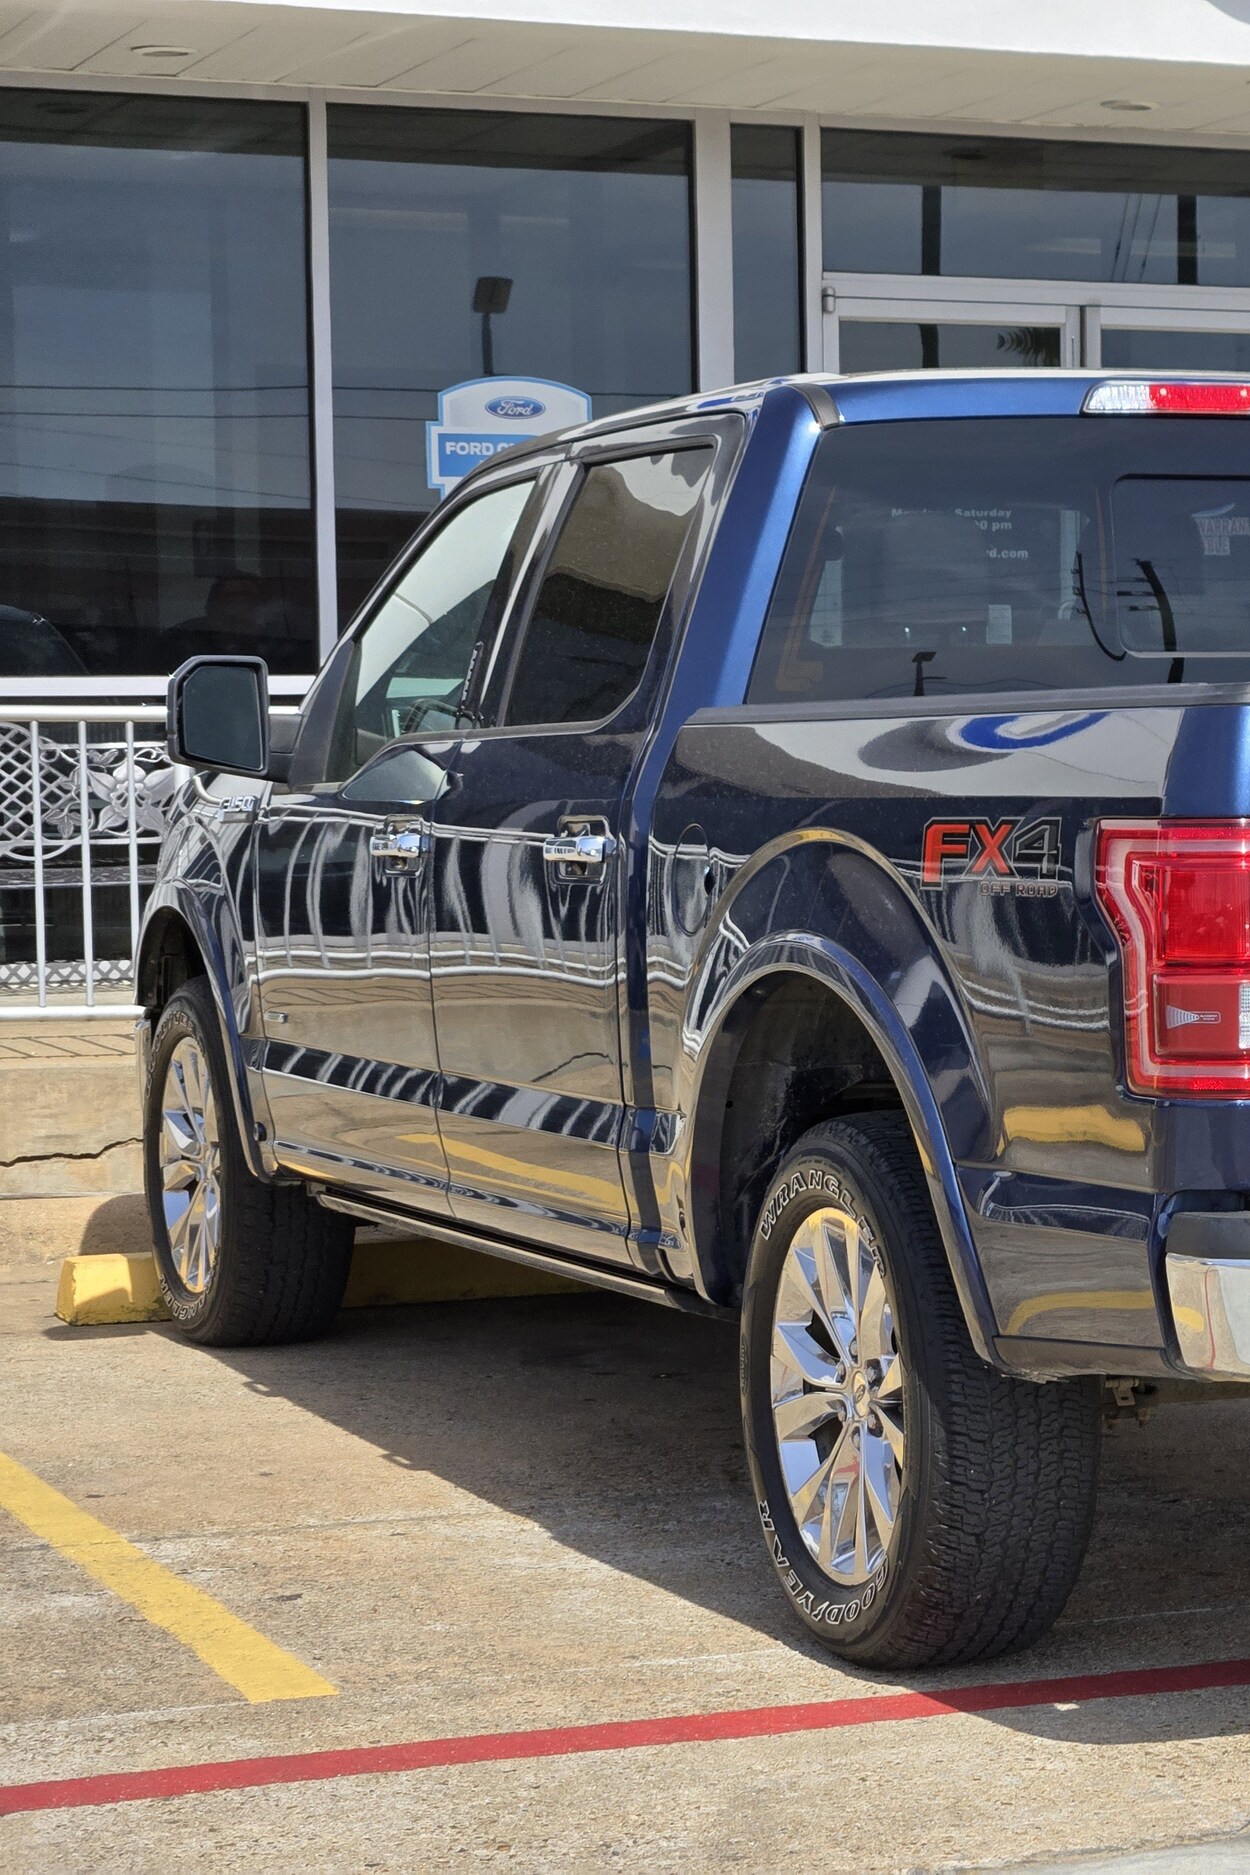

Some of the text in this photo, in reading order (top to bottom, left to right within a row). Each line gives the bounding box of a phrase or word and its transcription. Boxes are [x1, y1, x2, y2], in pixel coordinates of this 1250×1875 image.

[497, 400, 534, 415] Ford
[445, 441, 495, 455] FORD
[955, 508, 1012, 518] Saturday
[991, 521, 1012, 532] pm
[920, 817, 1062, 890] FX4
[980, 882, 1059, 898] OFF ROAD
[759, 1169, 887, 1280] WRANGLER
[758, 1500, 889, 1625] GOODYEAR
